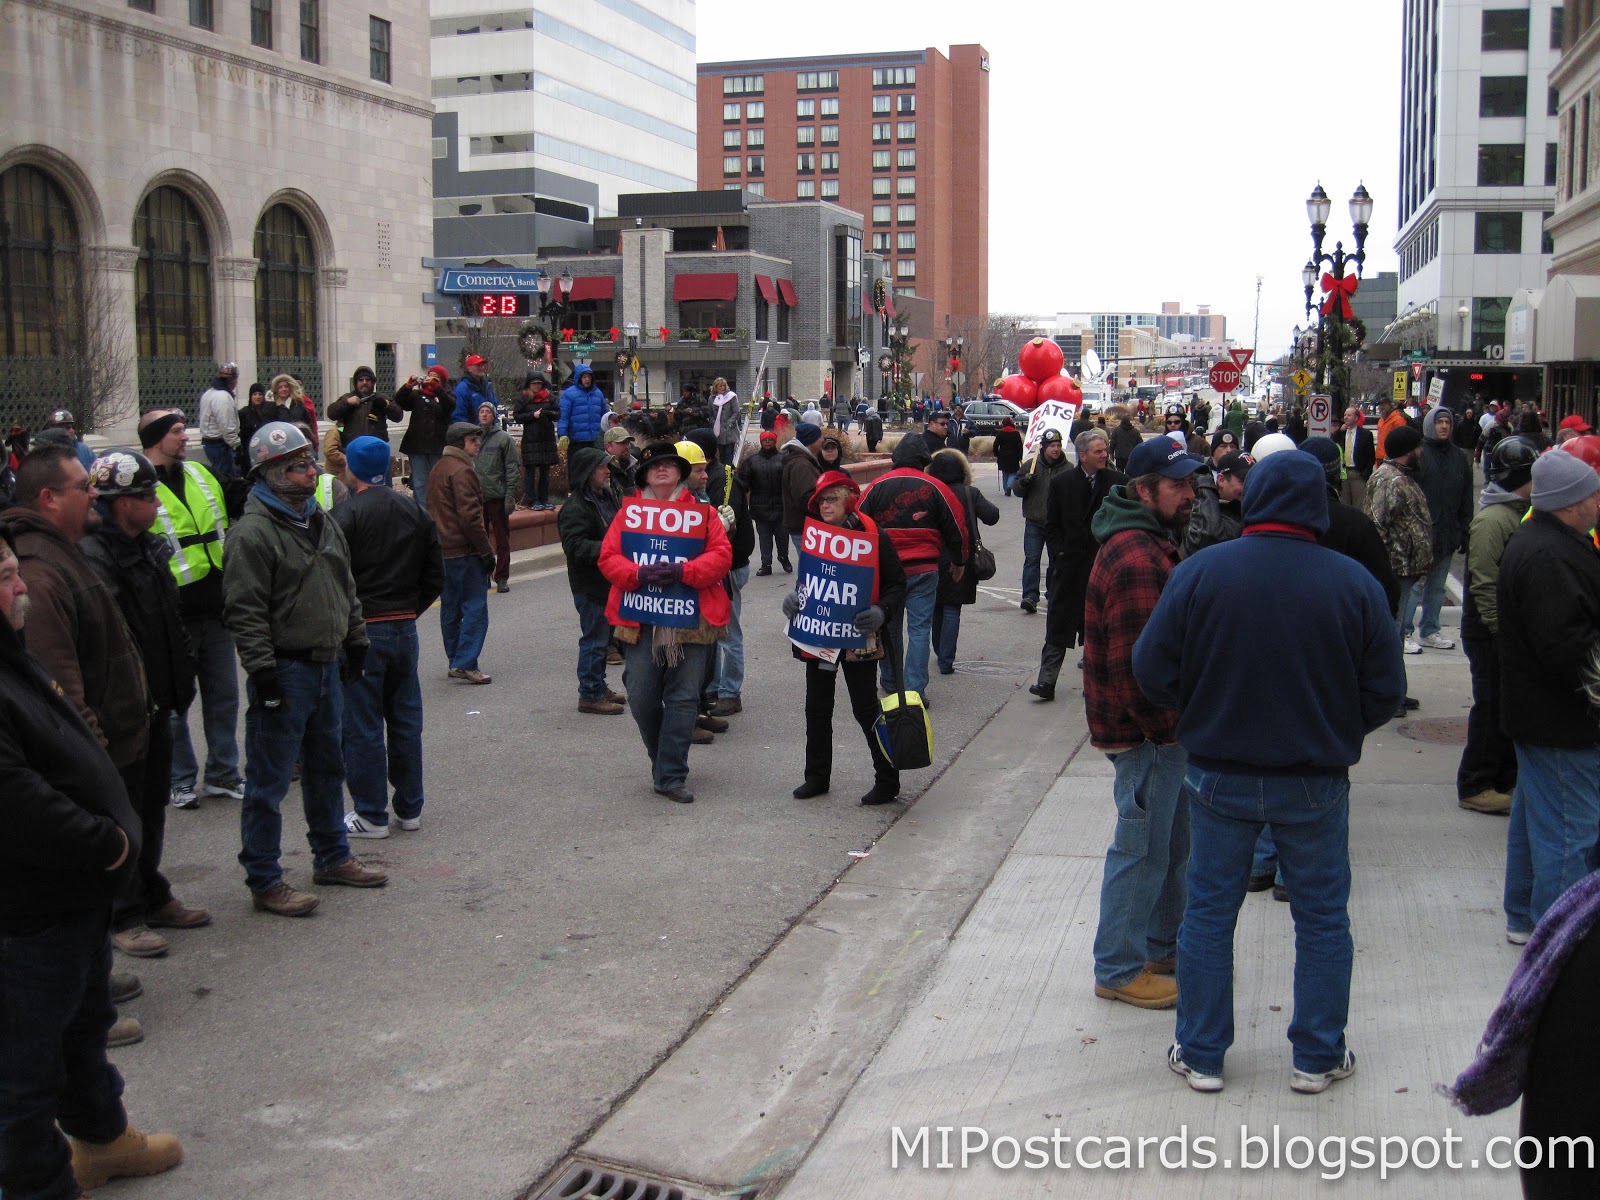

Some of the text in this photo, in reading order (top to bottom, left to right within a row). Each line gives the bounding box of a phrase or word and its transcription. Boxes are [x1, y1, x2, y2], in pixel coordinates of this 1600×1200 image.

[517, 278, 536, 286] Bank
[1211, 371, 1239, 383] STOP
[1031, 404, 1073, 426] RATS
[625, 504, 703, 533] STOP
[650, 538, 668, 551] THE
[804, 526, 873, 561] STOP
[820, 562, 837, 576] THE
[804, 573, 858, 606] WAR
[623, 592, 695, 615] WORKERS
[816, 604, 831, 617] ON
